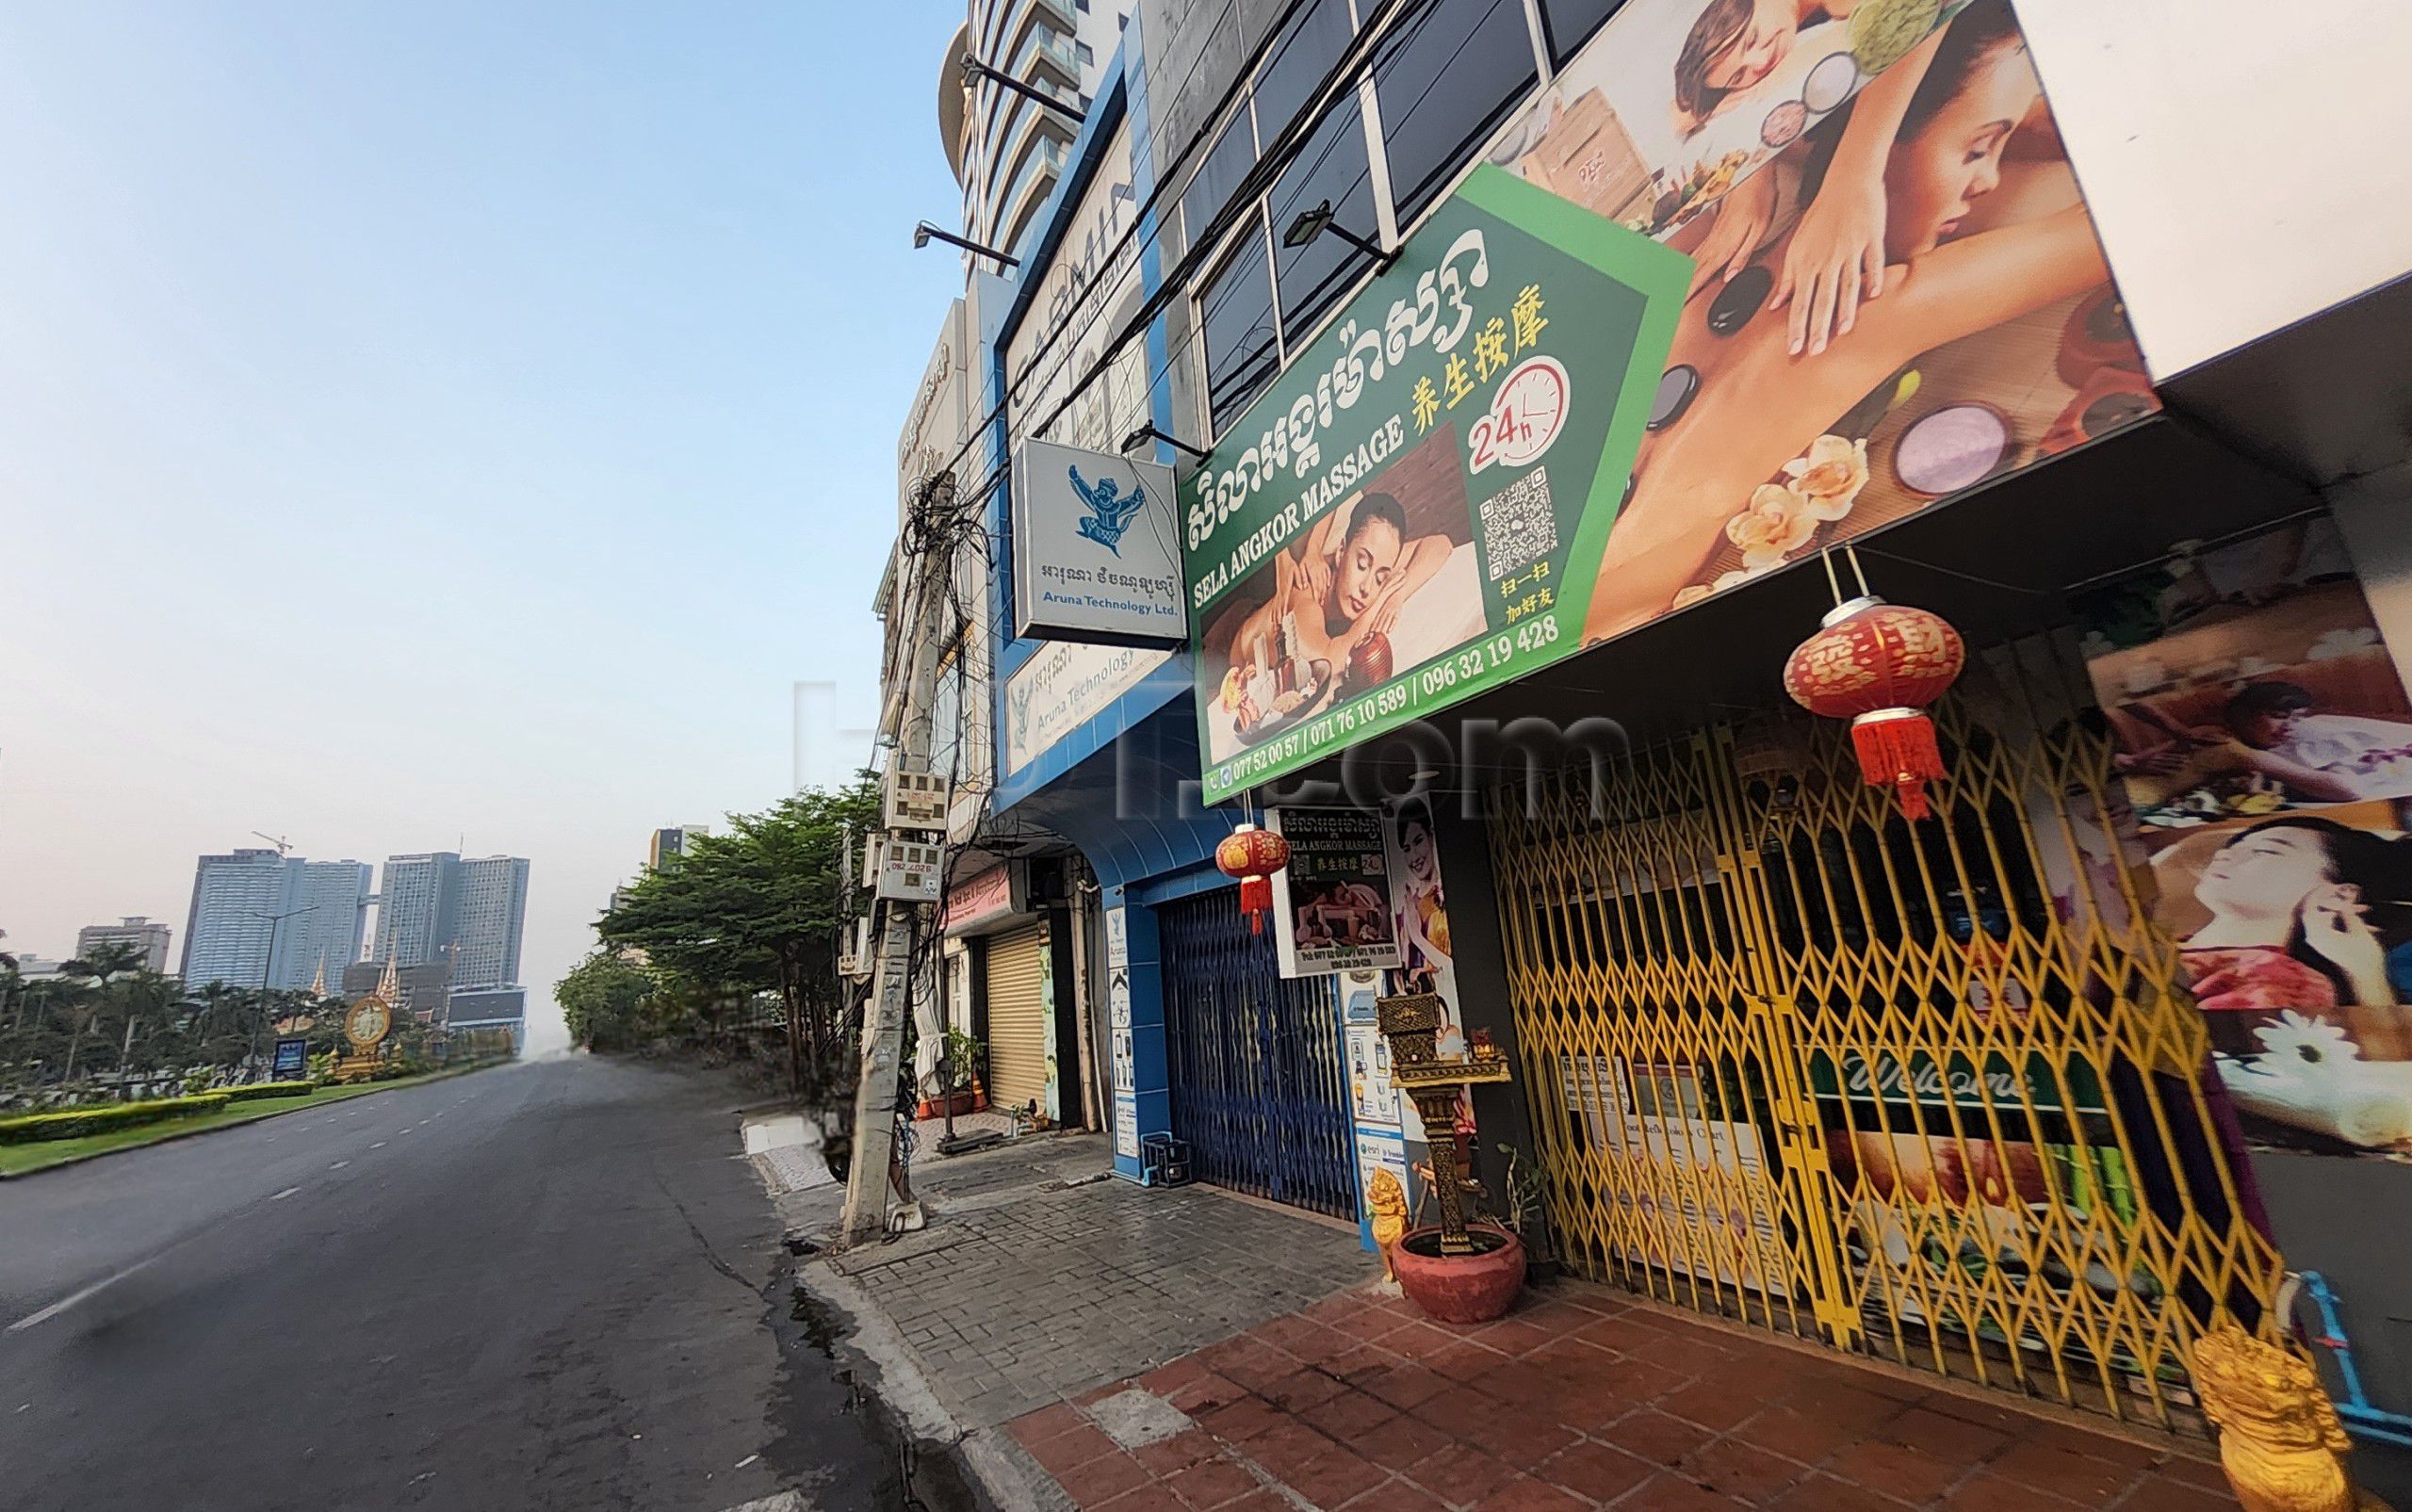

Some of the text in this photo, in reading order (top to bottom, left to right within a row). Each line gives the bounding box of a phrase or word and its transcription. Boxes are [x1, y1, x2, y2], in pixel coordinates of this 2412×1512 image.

[1411, 284, 1549, 437] 养生按摩
[1194, 414, 1404, 609] SELA ANGKOR MASSAGE
[1500, 561, 1550, 599] 扫一扫
[1043, 591, 1179, 616] Aruna Technology Ltd.
[1506, 587, 1556, 626] 加好友
[1037, 699, 1067, 732] Aruna
[1067, 646, 1134, 705] Technology
[1309, 839, 1344, 852] ANGKOR
